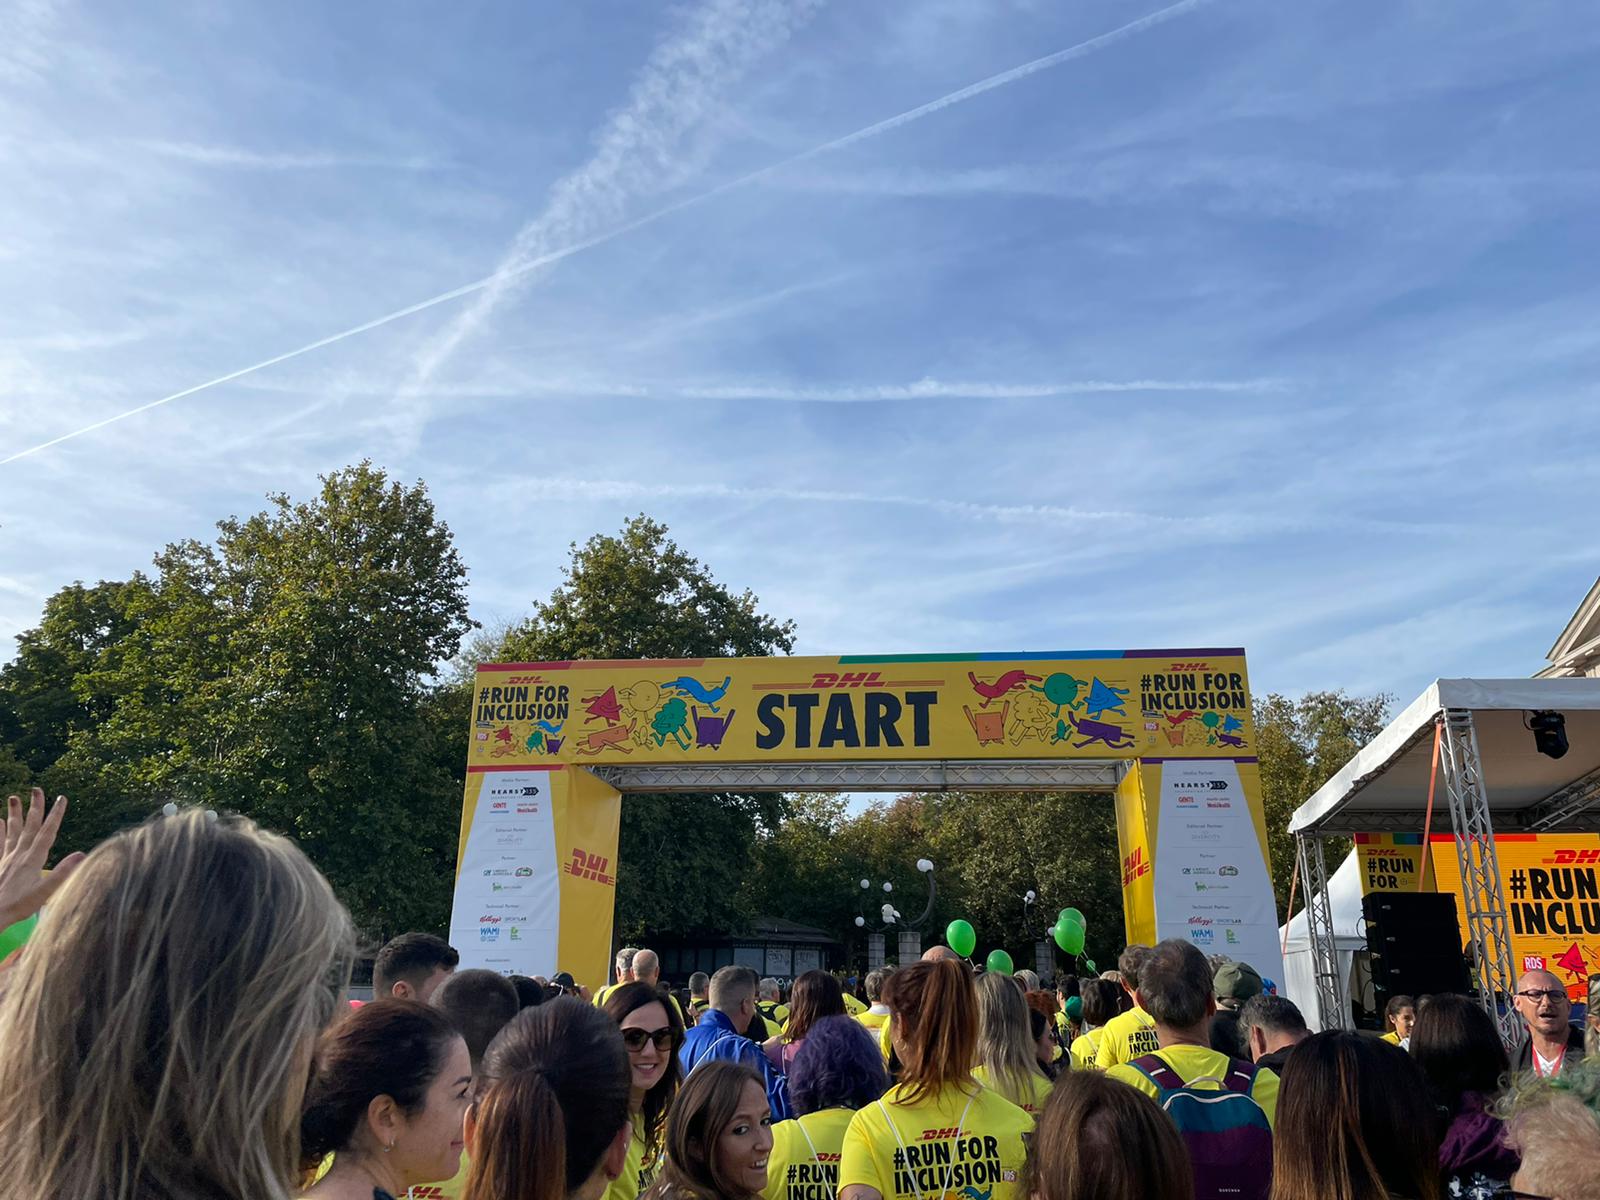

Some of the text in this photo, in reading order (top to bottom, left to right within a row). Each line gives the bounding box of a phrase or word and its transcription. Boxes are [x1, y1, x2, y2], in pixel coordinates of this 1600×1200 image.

[1170, 663, 1210, 671] DHL
[508, 676, 543, 684] DHL
[810, 672, 886, 688] DHL
[1140, 673, 1243, 691] #RUN FOR
[479, 685, 569, 703] #RUN FOR
[1141, 692, 1246, 711] INCLUSION
[476, 703, 569, 721] INCLUSION
[756, 691, 938, 749] START
[1368, 858, 1414, 873] #RUN
[1554, 850, 1600, 863] DH
[571, 848, 609, 884] DHL
[1369, 875, 1399, 888] FOR
[1510, 868, 1599, 900] #RUN
[1510, 902, 1600, 934] INCLU
[480, 927, 499, 935] WAMI
[1191, 929, 1214, 938] WAMI
[1525, 957, 1543, 969] RDS
[922, 1128, 963, 1140] DHL
[894, 1136, 998, 1170] #RUN FOR
[787, 1164, 837, 1183] #RUN
[894, 1160, 1001, 1194] INCLUSION
